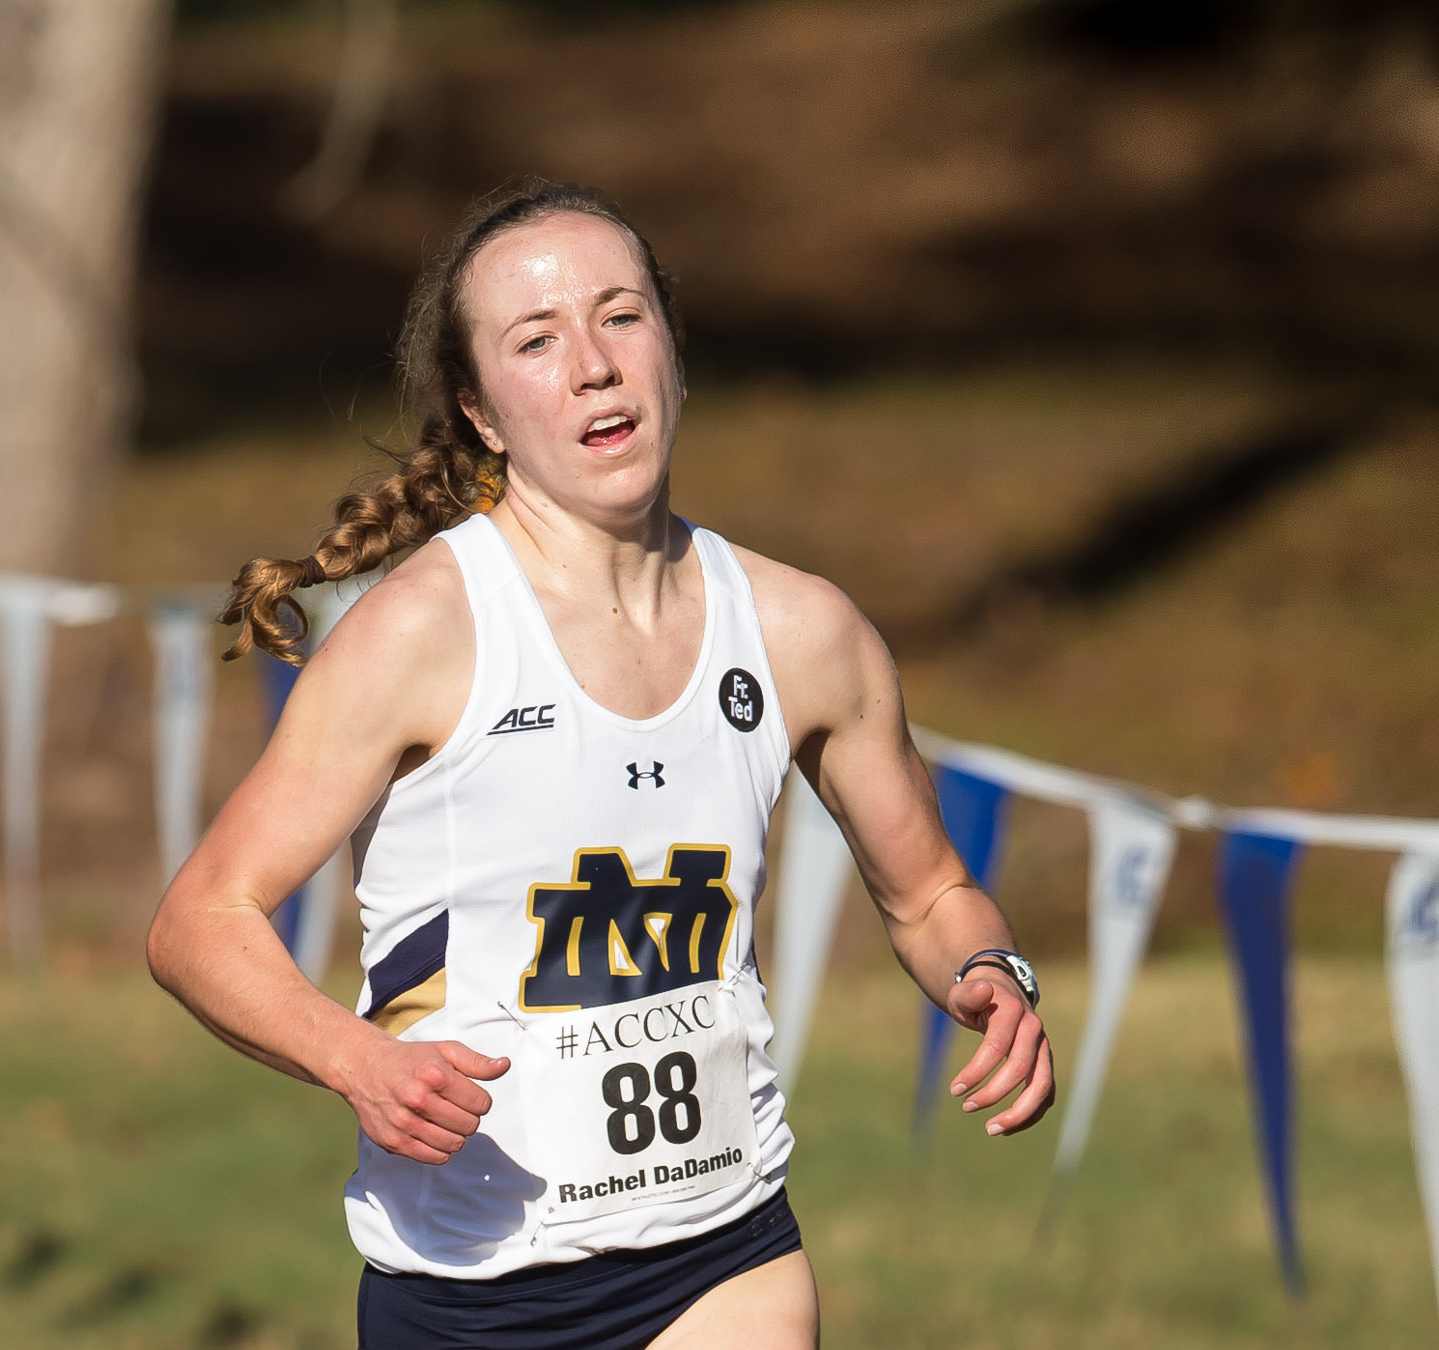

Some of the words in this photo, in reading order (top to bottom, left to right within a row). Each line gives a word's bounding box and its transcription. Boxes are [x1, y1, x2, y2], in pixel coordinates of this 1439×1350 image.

[728, 696, 753, 722] Ted
[733, 674, 749, 700] Ft.
[486, 703, 557, 736] ACC
[555, 995, 716, 1060] #ACCXC
[601, 1050, 702, 1155] 88
[558, 1169, 646, 1204] Rachel
[654, 1147, 743, 1185] DaDamio
